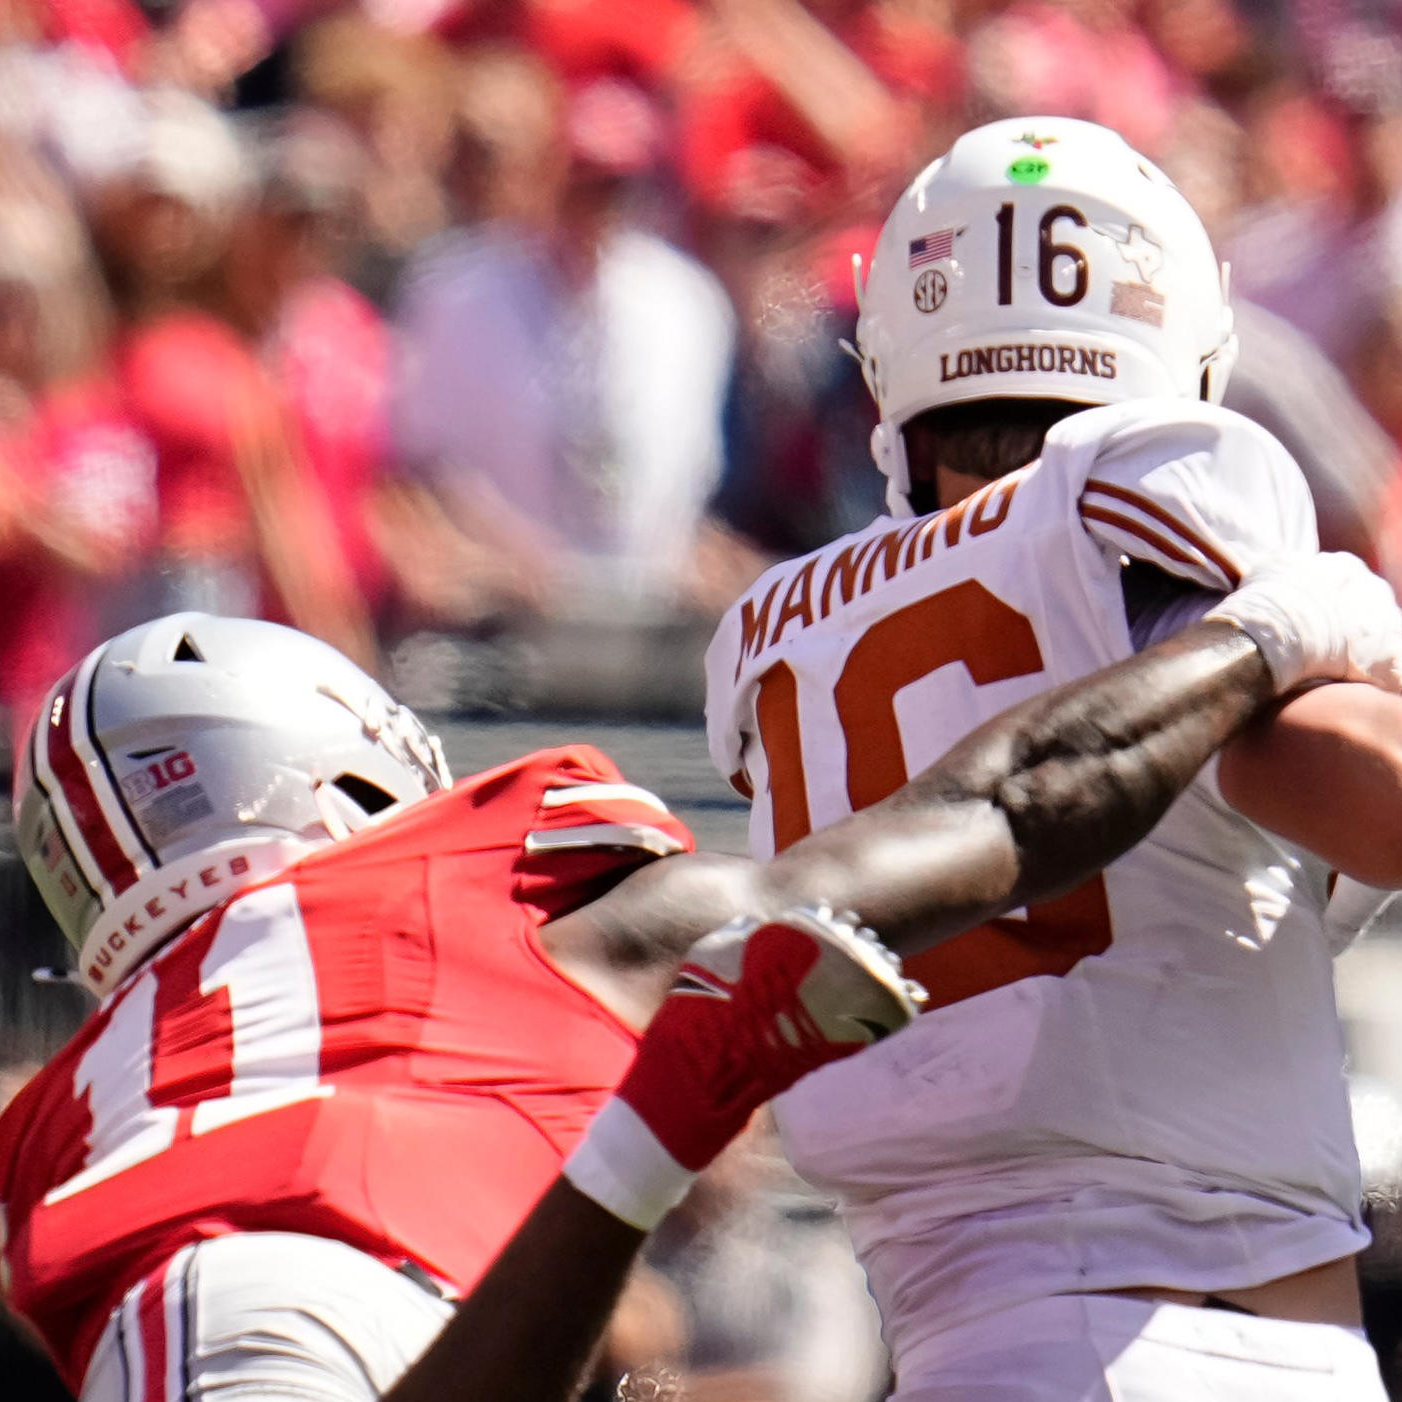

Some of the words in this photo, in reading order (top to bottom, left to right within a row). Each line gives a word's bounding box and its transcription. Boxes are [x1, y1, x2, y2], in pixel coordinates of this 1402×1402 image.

[996, 201, 1090, 308] 16
[940, 343, 1117, 382] LONGHORNS
[87, 855, 252, 985] BUCKEYES
[43, 883, 336, 1206] 11
